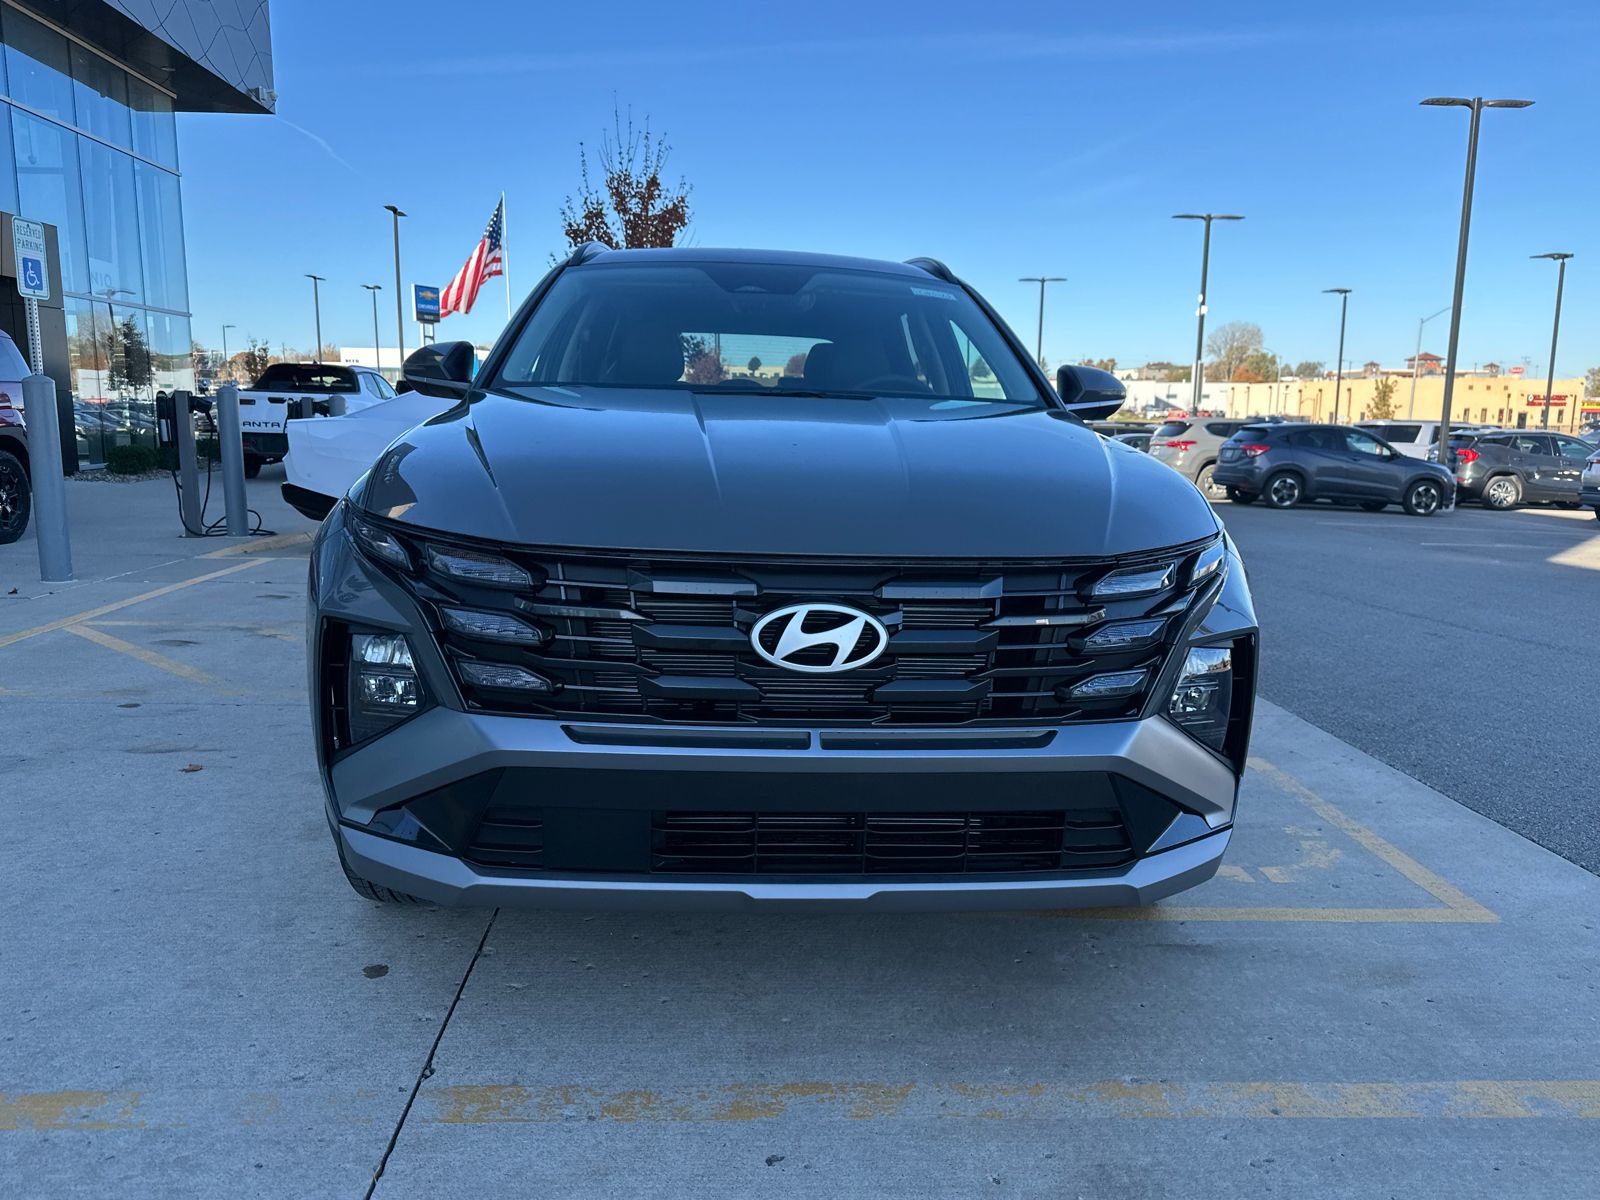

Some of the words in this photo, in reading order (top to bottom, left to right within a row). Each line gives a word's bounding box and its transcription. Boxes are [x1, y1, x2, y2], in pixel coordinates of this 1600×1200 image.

[16, 224, 42, 239] RESERVED
[17, 237, 43, 253] PARKING
[241, 420, 281, 428] ANTA
